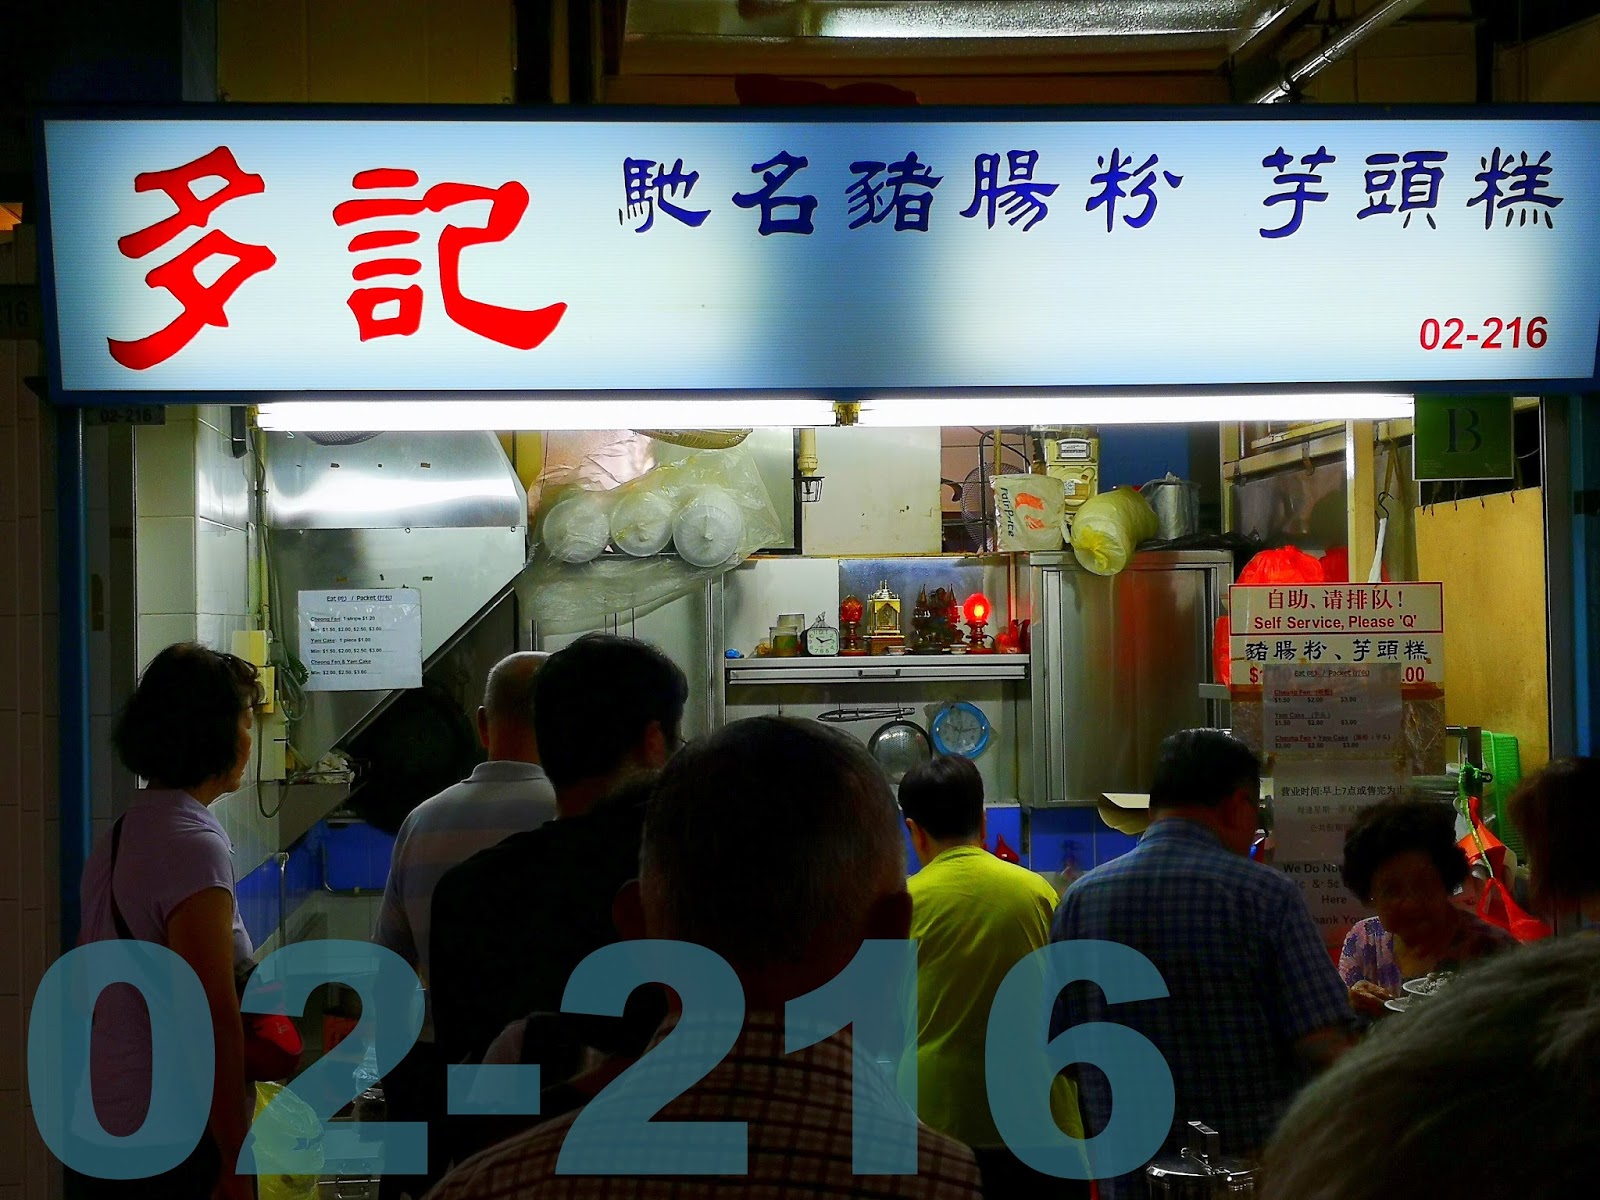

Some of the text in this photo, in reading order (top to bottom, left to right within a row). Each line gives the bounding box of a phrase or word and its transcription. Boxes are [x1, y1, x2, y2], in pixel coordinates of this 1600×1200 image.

[1259, 146, 1564, 239] 芋頭糕
[108, 146, 568, 371] 多記
[1419, 316, 1549, 351] 02-216
[1445, 408, 1482, 453] B
[1254, 617, 1282, 629] Self
[1287, 616, 1345, 631] Service,
[1348, 615, 1395, 628] Please
[1283, 863, 1300, 874] We
[1304, 863, 1320, 873] Do
[1321, 895, 1347, 904] Here
[1312, 915, 1337, 925] hank
